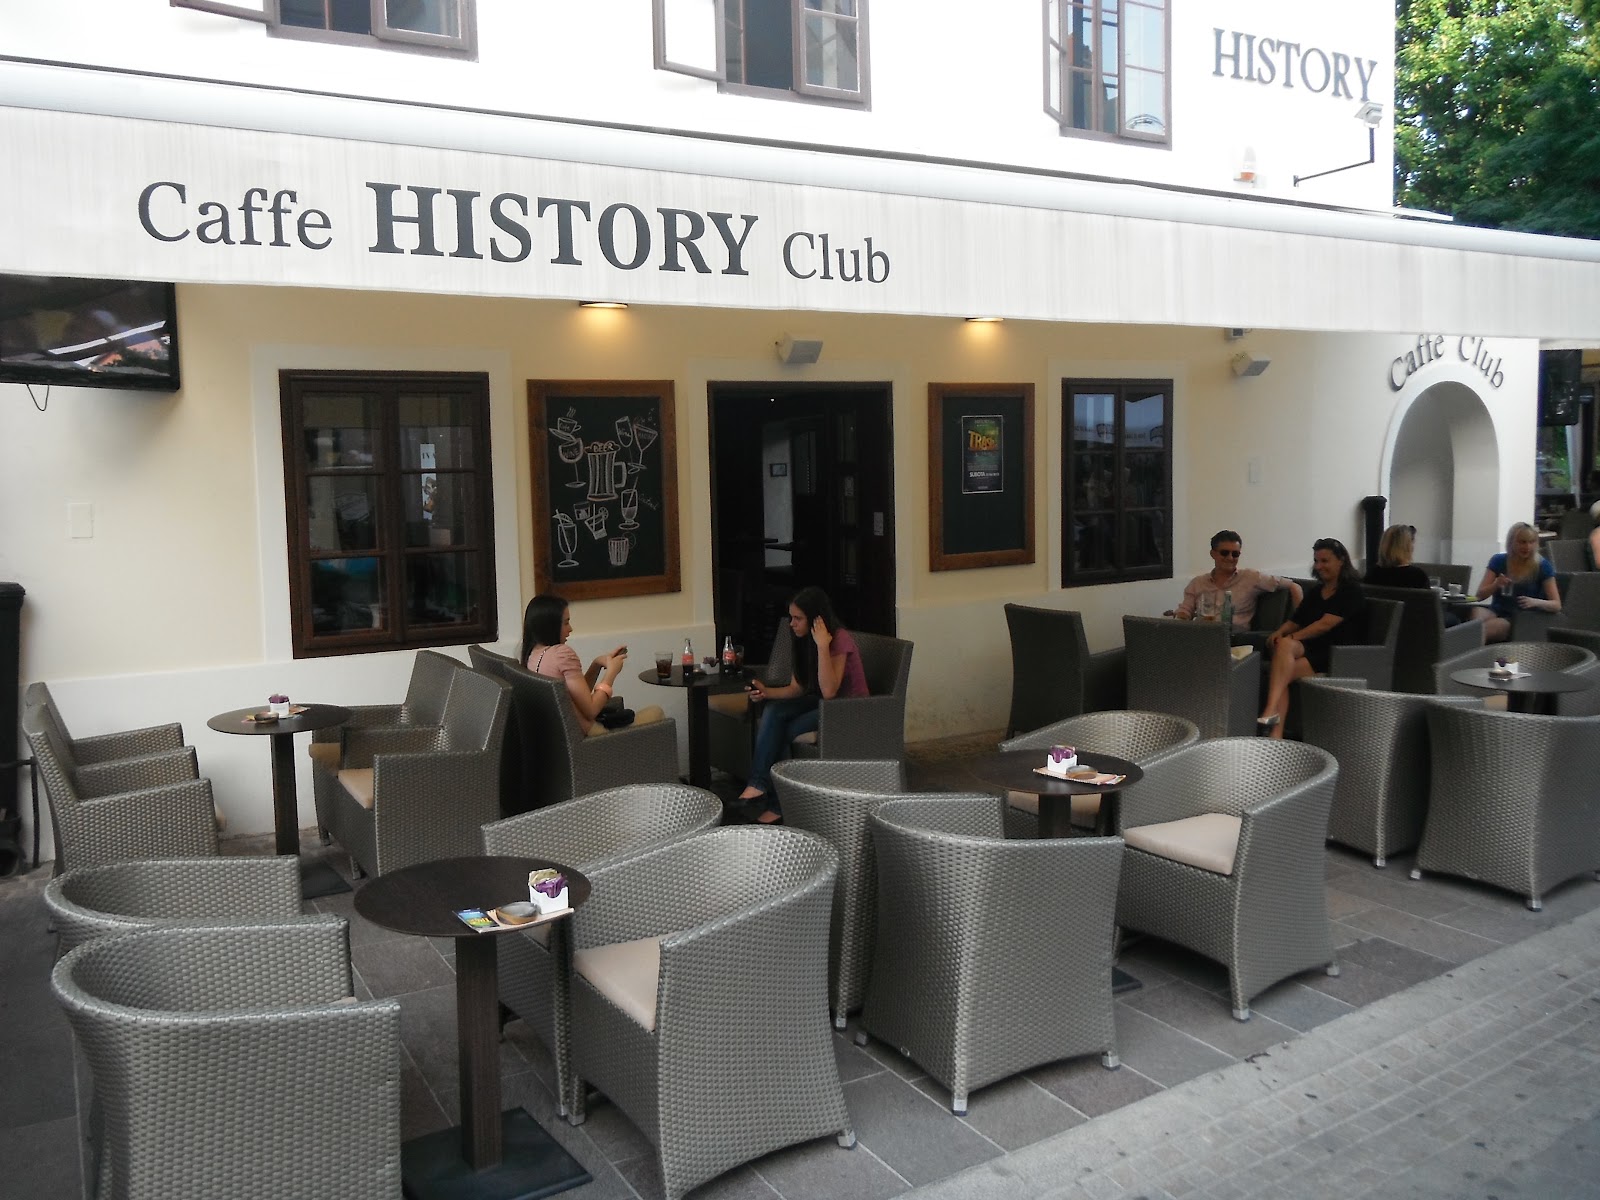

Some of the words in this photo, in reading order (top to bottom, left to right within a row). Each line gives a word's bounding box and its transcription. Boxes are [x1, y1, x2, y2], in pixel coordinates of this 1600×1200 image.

[1212, 27, 1378, 102] HISTORY
[138, 181, 333, 250] Caffe
[365, 181, 759, 276] HISTORY
[783, 231, 890, 284] Club
[1388, 334, 1444, 391] Caffe
[1459, 336, 1504, 388] Club
[593, 442, 615, 453] BEER
